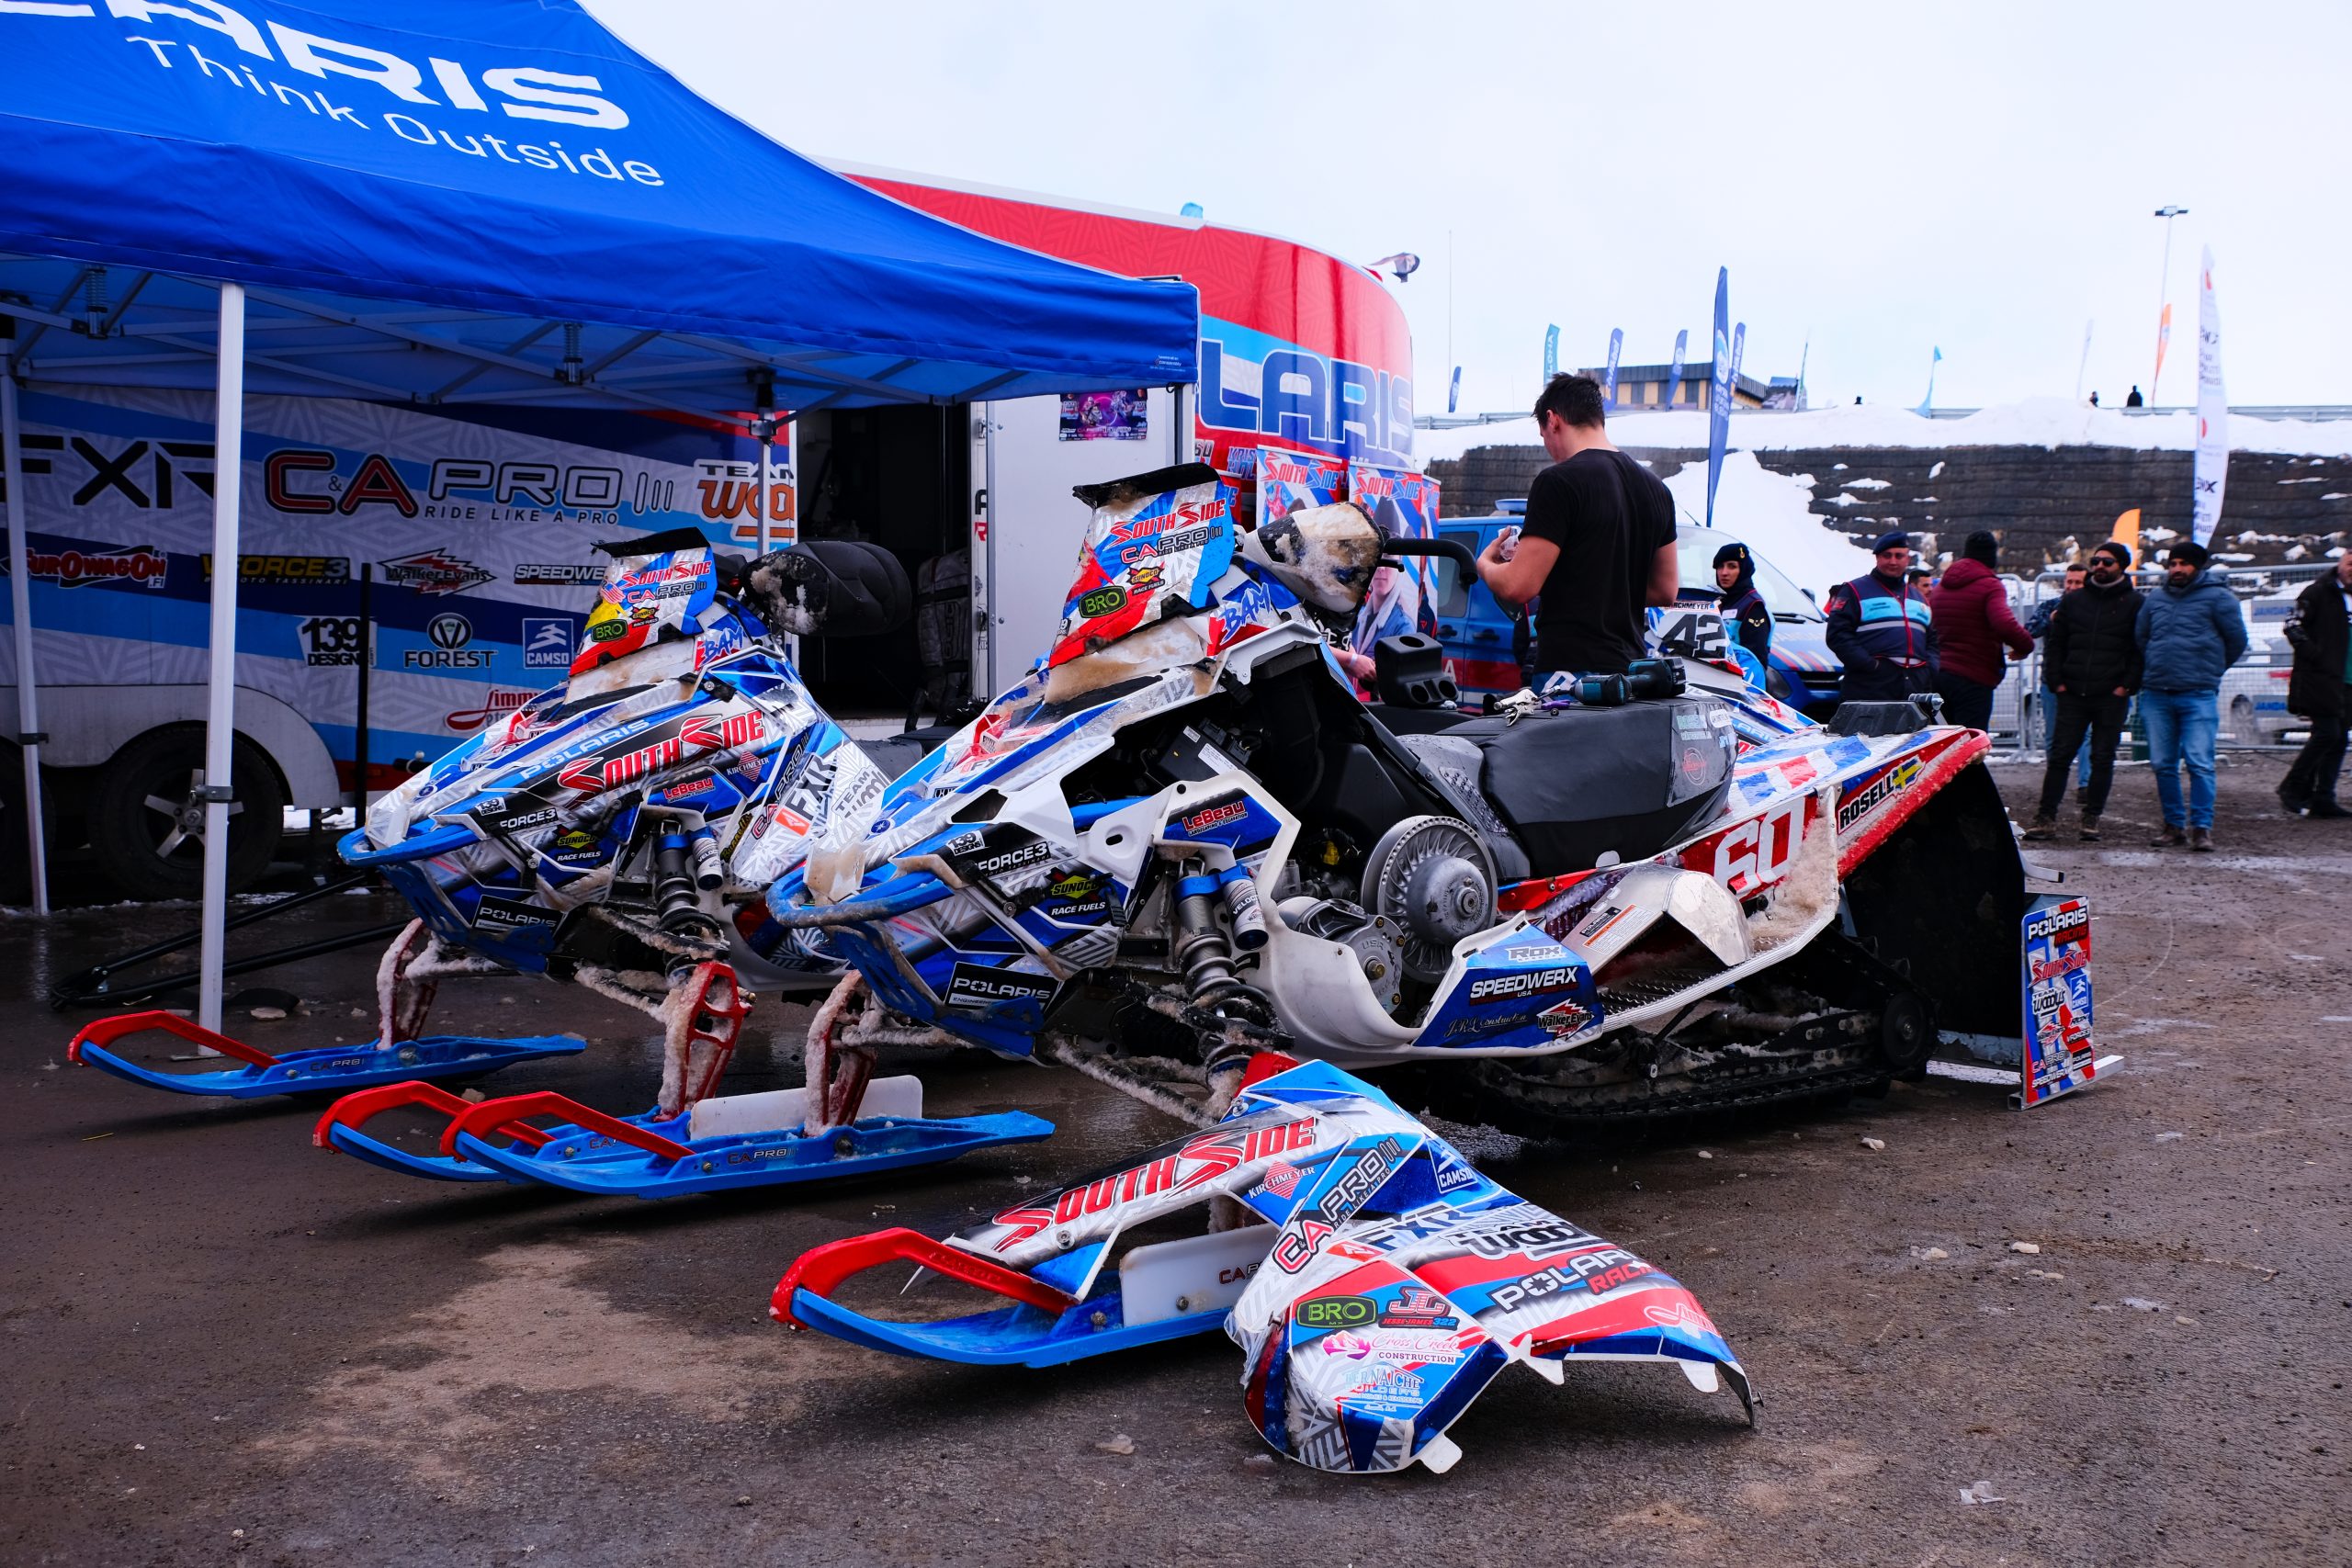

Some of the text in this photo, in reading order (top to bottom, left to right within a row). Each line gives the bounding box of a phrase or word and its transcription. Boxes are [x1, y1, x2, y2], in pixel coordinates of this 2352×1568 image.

[0, 0, 629, 130] ARIS
[125, 35, 665, 187] Think Outside
[1198, 338, 1412, 454] LARIS
[1227, 447, 1257, 463] KRIS
[1260, 451, 1308, 485] SOUTH
[1304, 459, 1340, 491] SIDE
[428, 457, 623, 510] PRO
[1352, 467, 1394, 498] SOUTH
[1387, 471, 1421, 501] SIDE
[424, 506, 618, 525] RIDE LIKE A PRO
[1104, 499, 1227, 551] SOUTH SIDE
[1157, 526, 1209, 552] PRO
[514, 565, 606, 580] SPEEDWE
[620, 560, 712, 589] SOUTH SIDE
[1131, 570, 1159, 582] SUNOCO
[1133, 581, 1165, 594] RACE FUELS
[1085, 589, 1120, 614] BRO
[1218, 582, 1273, 646] BAM
[301, 617, 361, 653] 139
[596, 624, 623, 638] BRO
[1660, 614, 1726, 659] 42
[701, 626, 746, 665] BAM
[308, 653, 361, 667] DESIGN
[403, 650, 493, 669] FOREST
[526, 652, 570, 666] CAMSO
[520, 720, 650, 780] POLARIS
[558, 709, 765, 811] SOUTH SIDE
[726, 757, 770, 776] KIRCHMEYER
[662, 777, 714, 800] LeBeau
[835, 770, 870, 813] TEAM
[478, 798, 500, 810] 139
[1838, 775, 1894, 826] ROSELL
[1182, 800, 1246, 832] LeBeau
[558, 832, 596, 846] SUNOCO
[948, 832, 977, 849] 139
[1713, 795, 1805, 895] 60
[557, 851, 602, 863] RACE FUELS
[1051, 881, 1100, 897] SUNOCO
[479, 907, 558, 928] POLARIS
[1051, 901, 1106, 917] RACE FUELS
[2028, 907, 2087, 941] POLARIS
[2054, 924, 2087, 945] RACING
[2028, 950, 2087, 988] SOUTH SIDE
[953, 977, 1051, 999] POLARIS
[1470, 966, 1578, 998] SPEEDWERX
[2033, 988, 2054, 998] TEAM
[1517, 989, 1532, 998] USA
[1538, 1011, 1593, 1030] Walker Evans
[332, 1057, 361, 1068] PRO
[753, 1147, 787, 1159] PRO
[992, 1116, 1317, 1253] SOUTH SIDE
[1249, 1166, 1316, 1200] KIRCHMEYER
[1318, 1147, 1386, 1222] PRO
[1438, 1168, 1473, 1189] CAMSO
[1333, 1208, 1351, 1230] RIDE
[1351, 1191, 1370, 1211] LIKE
[1376, 1167, 1391, 1185] PRO
[1491, 1250, 1637, 1312] POLARI
[1307, 1302, 1366, 1322] BRO
[1432, 1317, 1457, 1326] 322
[1372, 1332, 1460, 1352] Cross Creek
[1378, 1351, 1454, 1363] CONSTRUCTION
